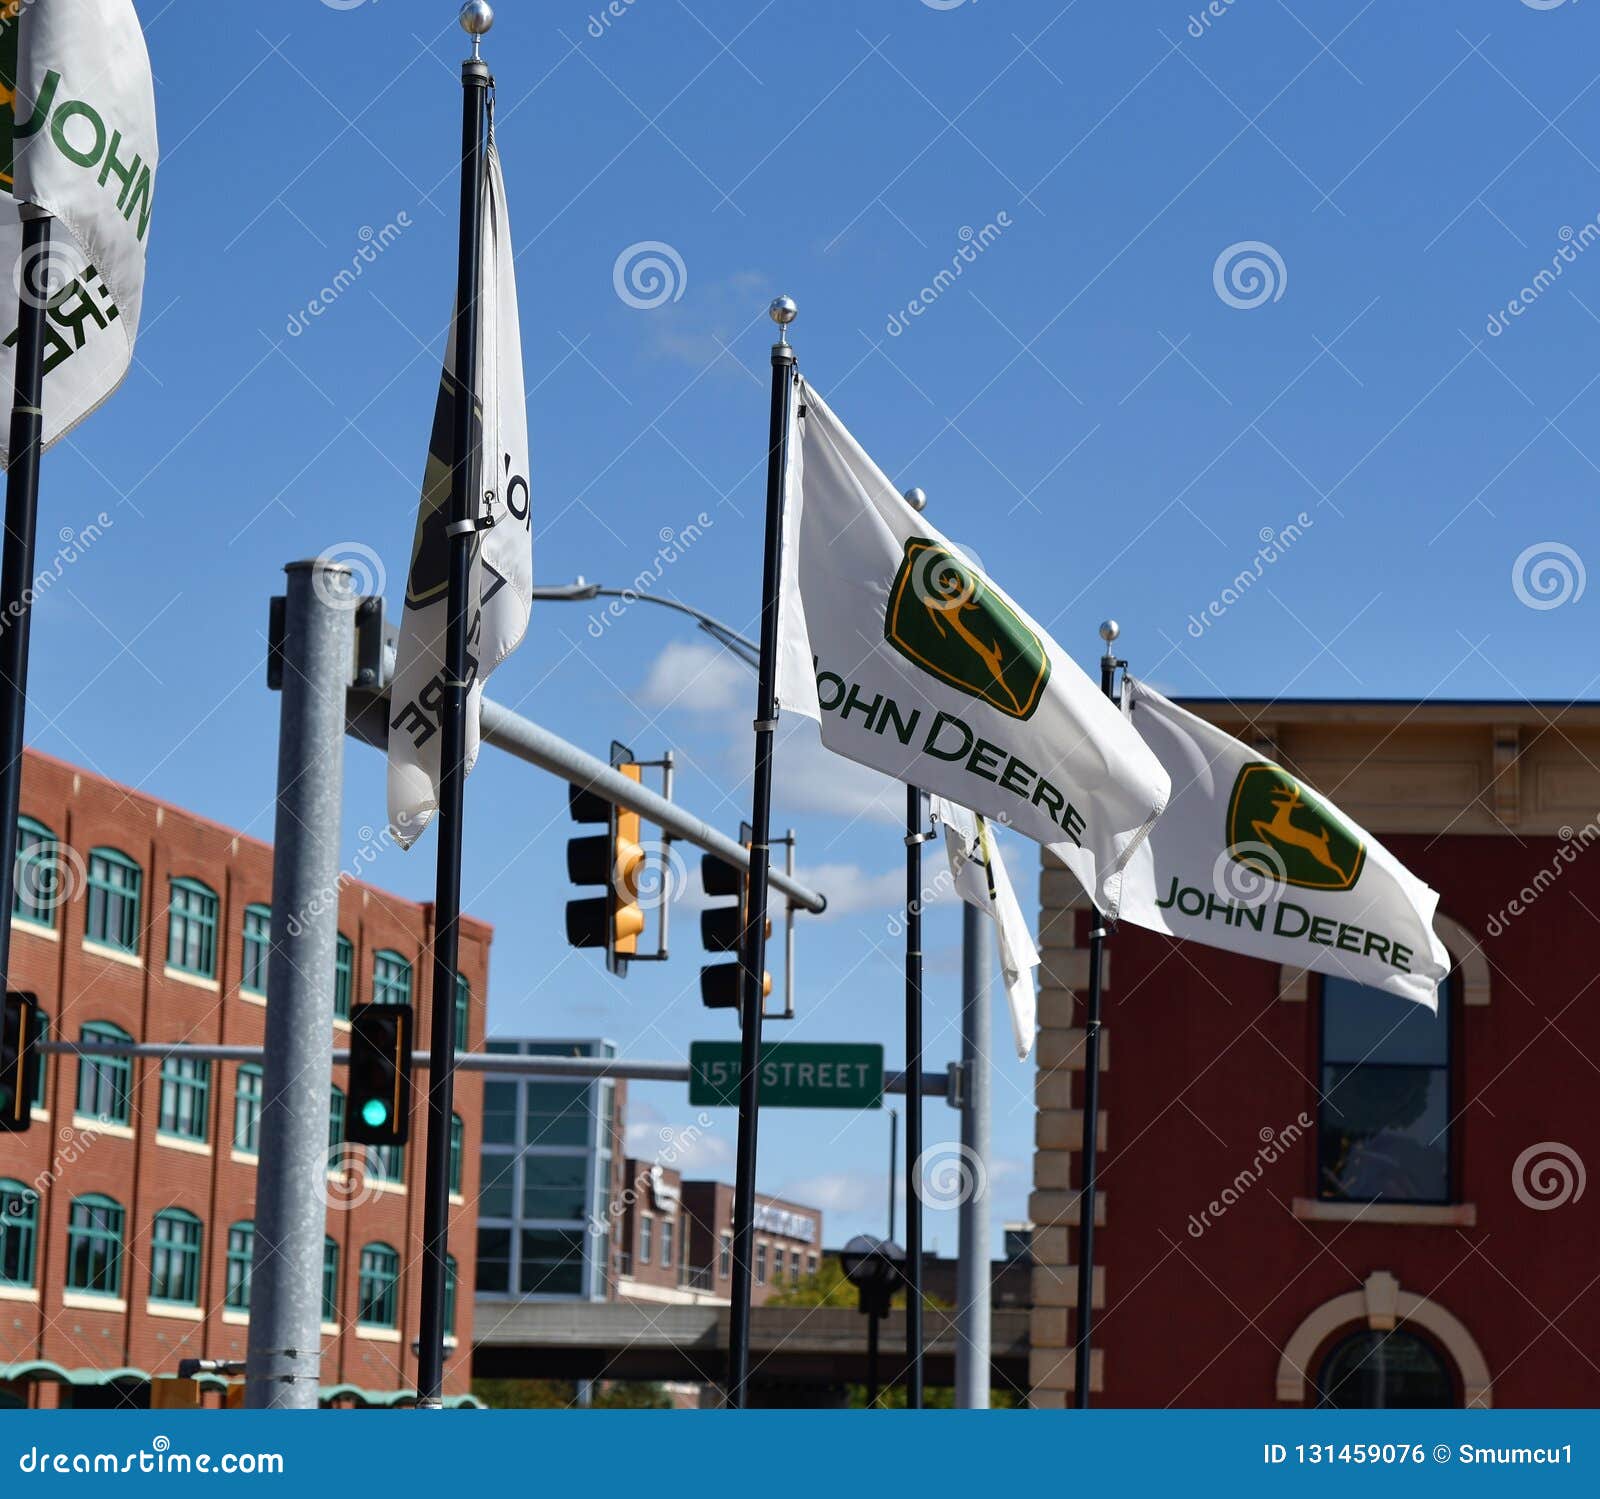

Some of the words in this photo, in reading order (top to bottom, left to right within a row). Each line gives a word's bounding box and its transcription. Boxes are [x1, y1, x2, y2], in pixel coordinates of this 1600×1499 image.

[13, 69, 152, 242] JOHN
[812, 655, 921, 745] OHN
[922, 710, 1087, 848] DEERE
[1154, 876, 1267, 932] JOHN
[1272, 901, 1414, 974] DEERE
[762, 1062, 870, 1088] STREET
